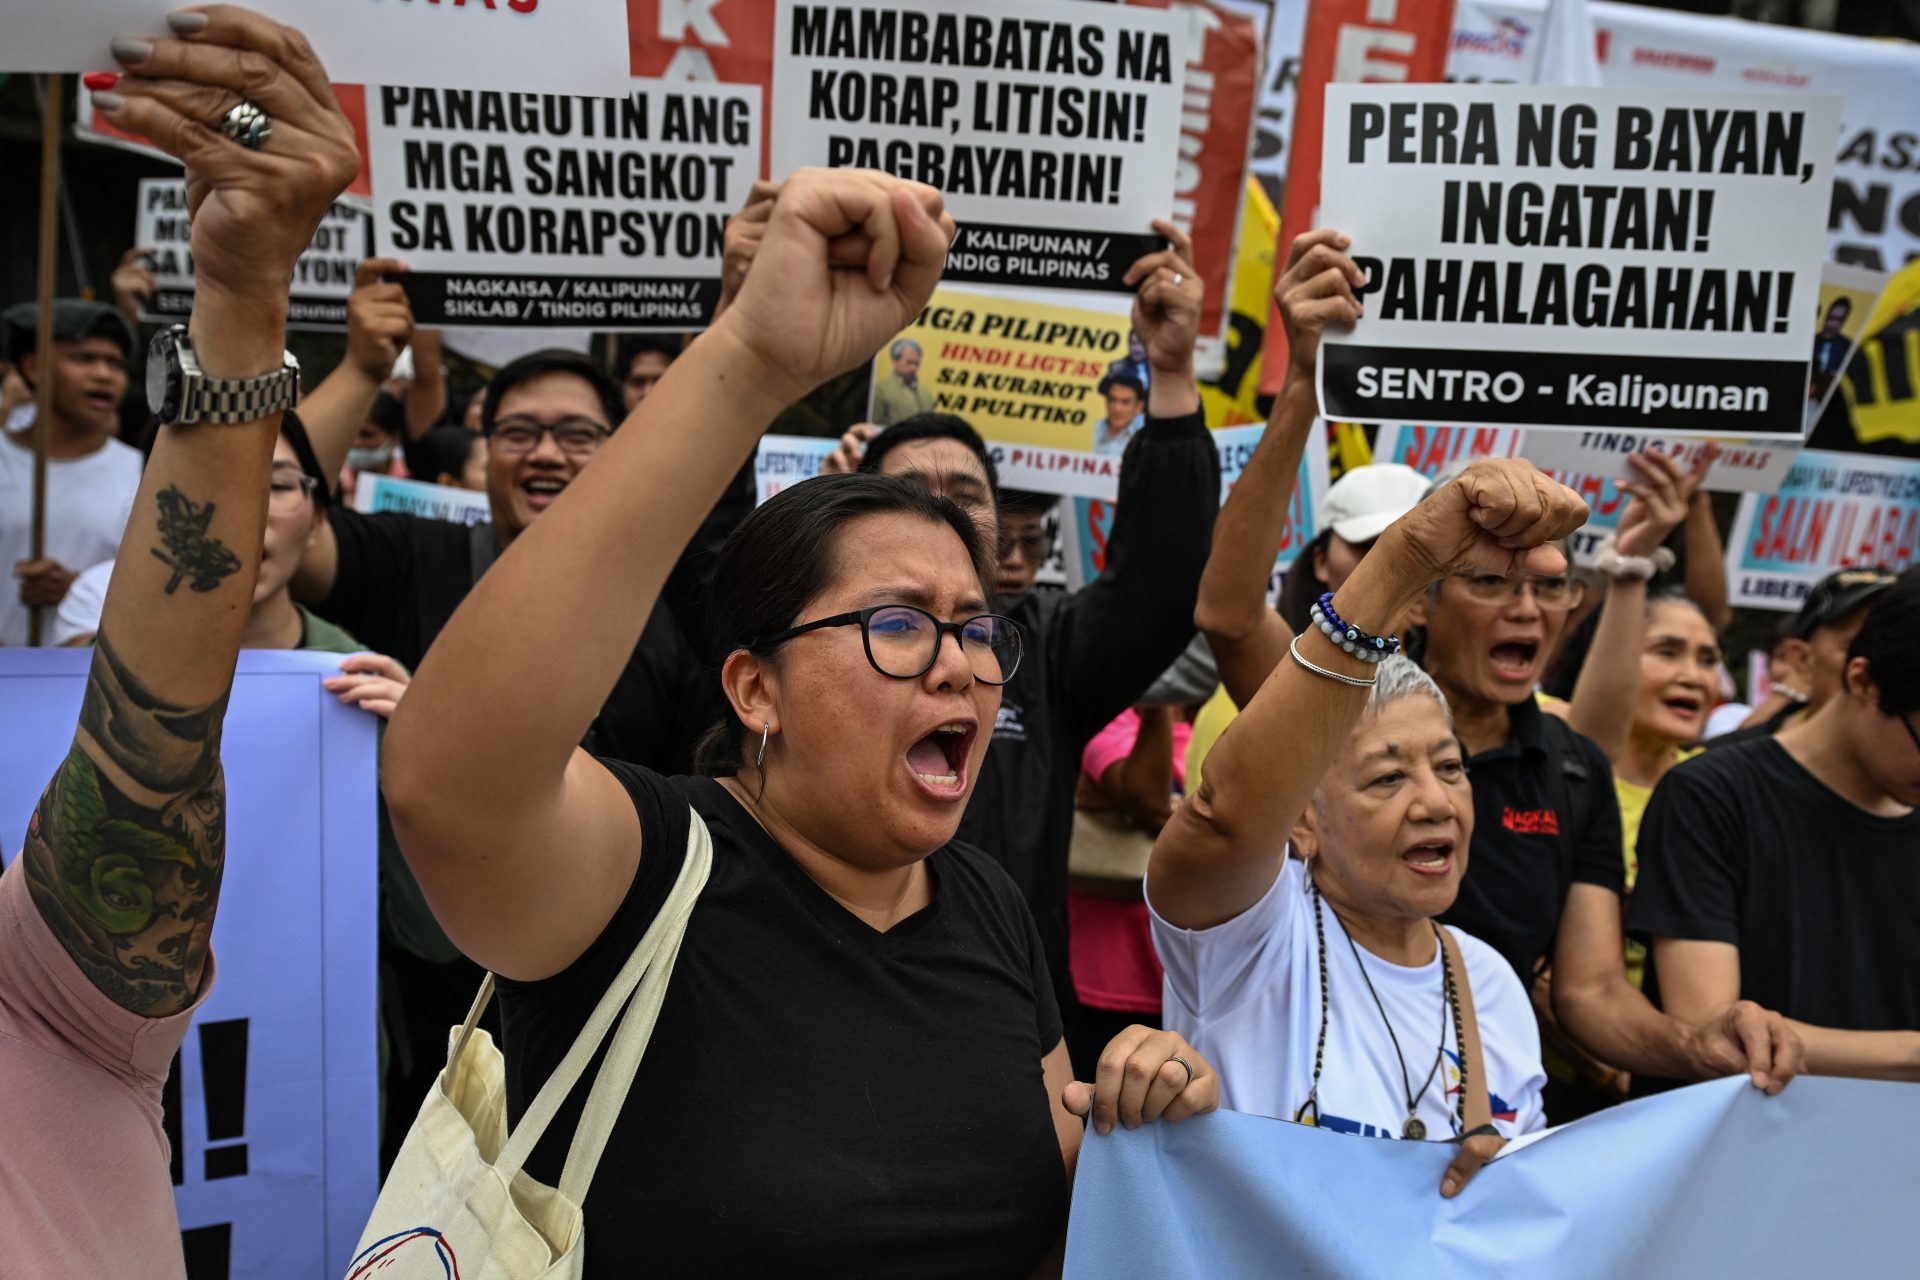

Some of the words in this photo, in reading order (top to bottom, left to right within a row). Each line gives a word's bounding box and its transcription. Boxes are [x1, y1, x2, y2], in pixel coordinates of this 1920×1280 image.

[791, 5, 1104, 77] MAMBABATAS
[1116, 29, 1172, 84] NA
[661, 94, 750, 146] ANG
[809, 69, 960, 136] KORAP,
[972, 81, 1148, 143] LITISIN!
[1348, 102, 1500, 166] PERA
[1516, 103, 1599, 169] NG
[1614, 106, 1815, 184] BAYAN,
[404, 140, 513, 193] MGA
[524, 146, 734, 203] SANGKOT
[828, 136, 1123, 205] PAGBAYARIN!
[390, 200, 453, 252] SA
[1440, 180, 1716, 253] INGATAN!
[966, 230, 1092, 255] KALIPUNAN
[446, 279, 553, 298] NAGKAISA
[573, 281, 686, 299] KALIPUNAN
[1006, 256, 1110, 280] PILIPINAS
[444, 300, 519, 317] SIKLAB
[538, 301, 607, 318] TINDIG
[611, 302, 703, 318] PILIPINAS
[1354, 256, 1795, 335] PAHALAGAHAN!
[980, 313, 1121, 352] PILIPINO
[936, 367, 970, 387] SA
[973, 370, 1092, 402] KURAKOT
[939, 341, 1011, 367] HINDI
[1015, 352, 1102, 379] LIGTAS
[934, 391, 966, 412] NA
[970, 395, 1088, 427] PULITIKO
[1355, 366, 1525, 404] SENTRO
[1566, 373, 1770, 413] Kalipunan
